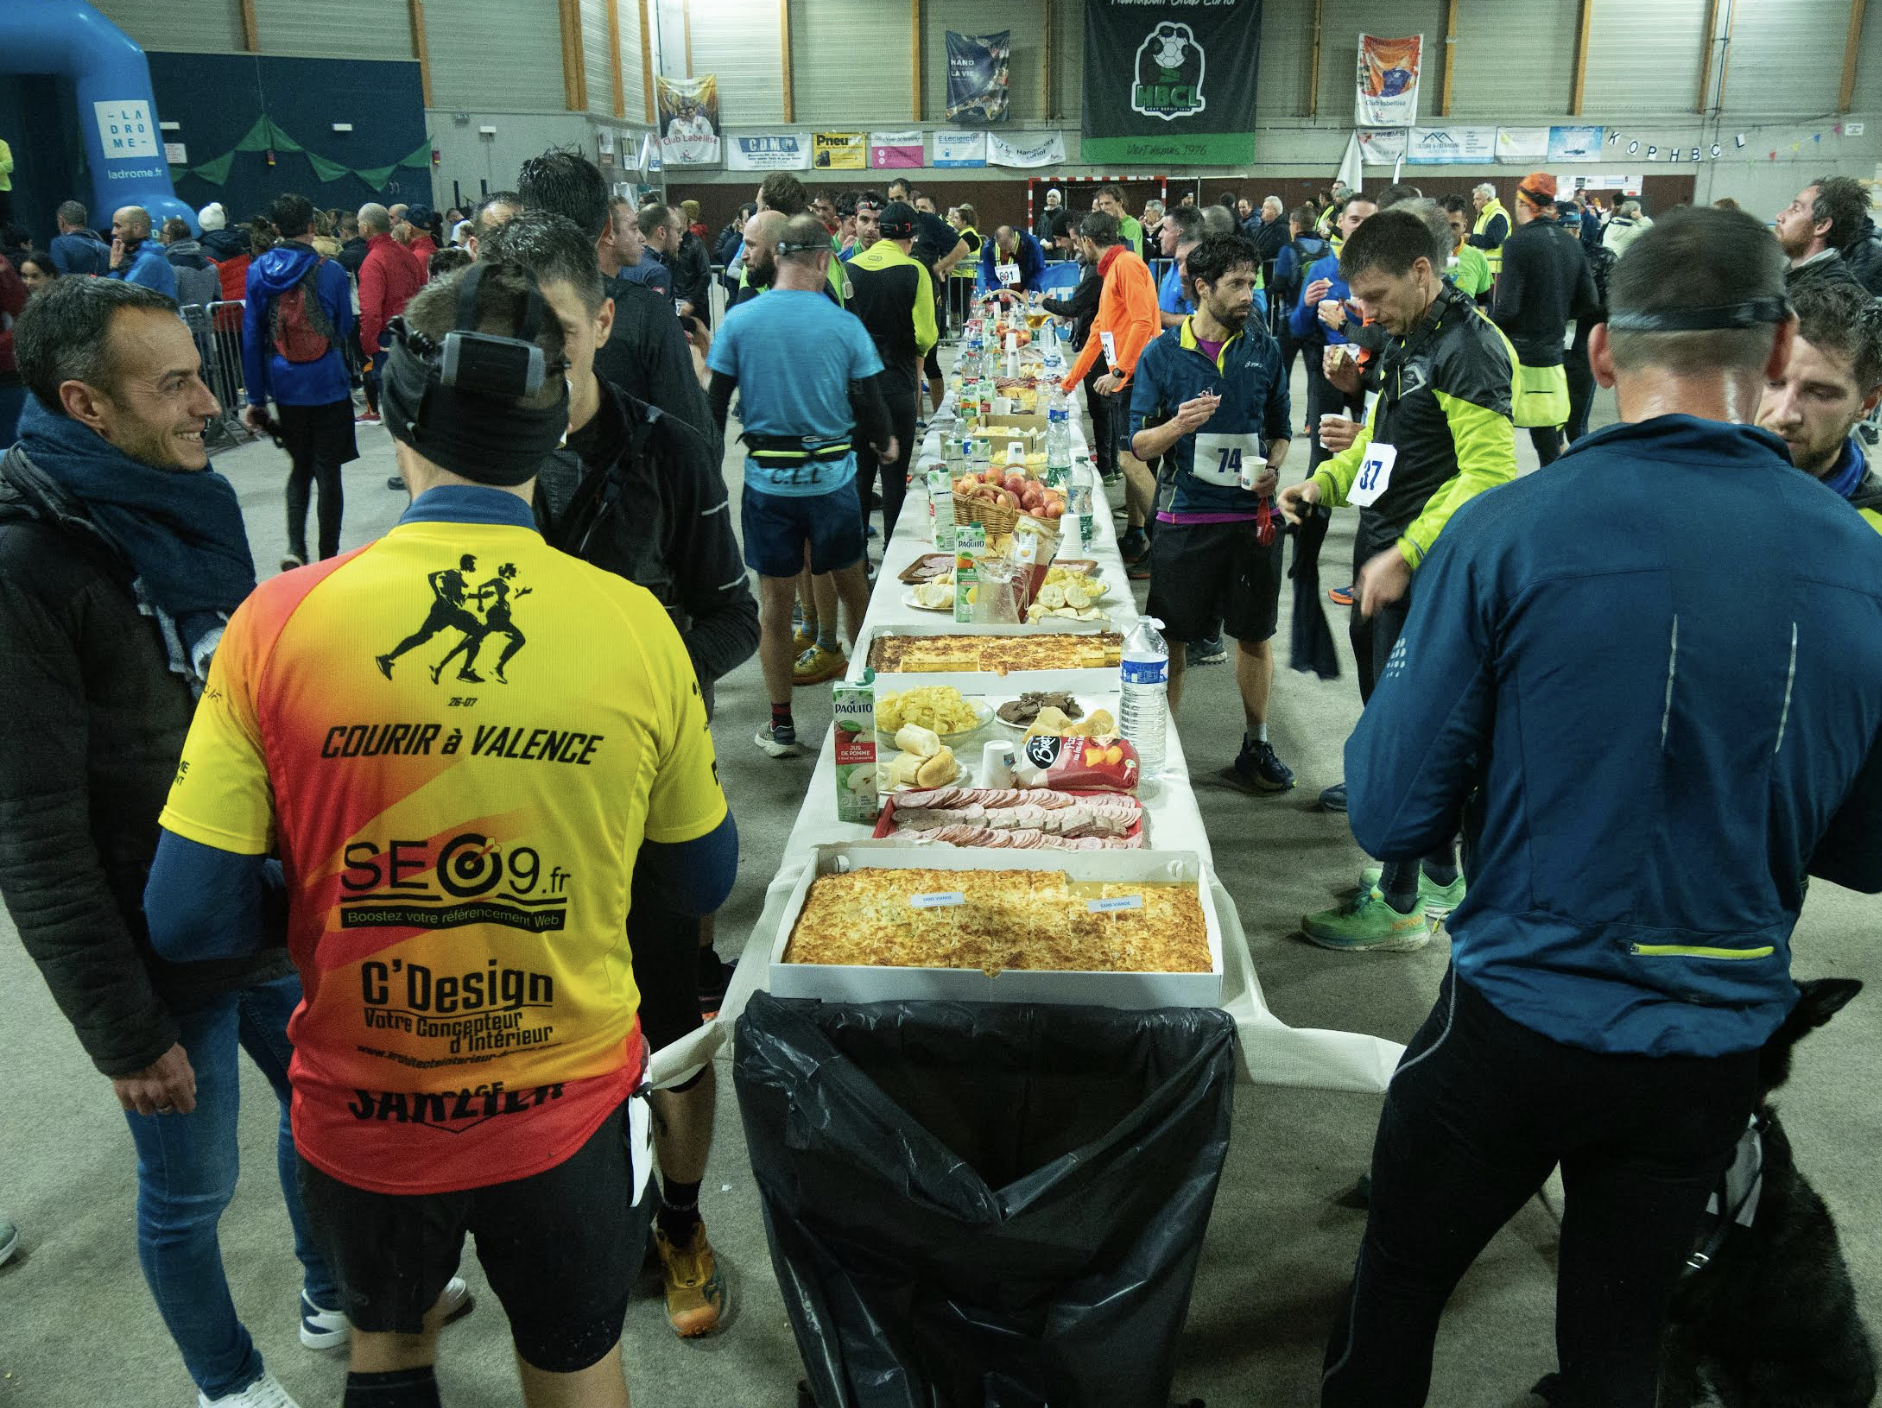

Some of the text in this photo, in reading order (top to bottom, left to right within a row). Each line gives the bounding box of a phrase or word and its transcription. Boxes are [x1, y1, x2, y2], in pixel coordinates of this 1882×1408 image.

[1136, 84, 1202, 107] HBCL
[663, 134, 681, 146] Club
[107, 167, 162, 179] ladrome.fr
[1217, 447, 1242, 473] 74
[1359, 459, 1383, 491] 37
[835, 703, 873, 714] PAQUITO
[321, 723, 604, 765] COURIR à VALENCE
[348, 906, 560, 928] Boostez votre référencement Web
[364, 1007, 523, 1039] Votre Concepteur
[450, 1025, 553, 1054] d'Intérieur
